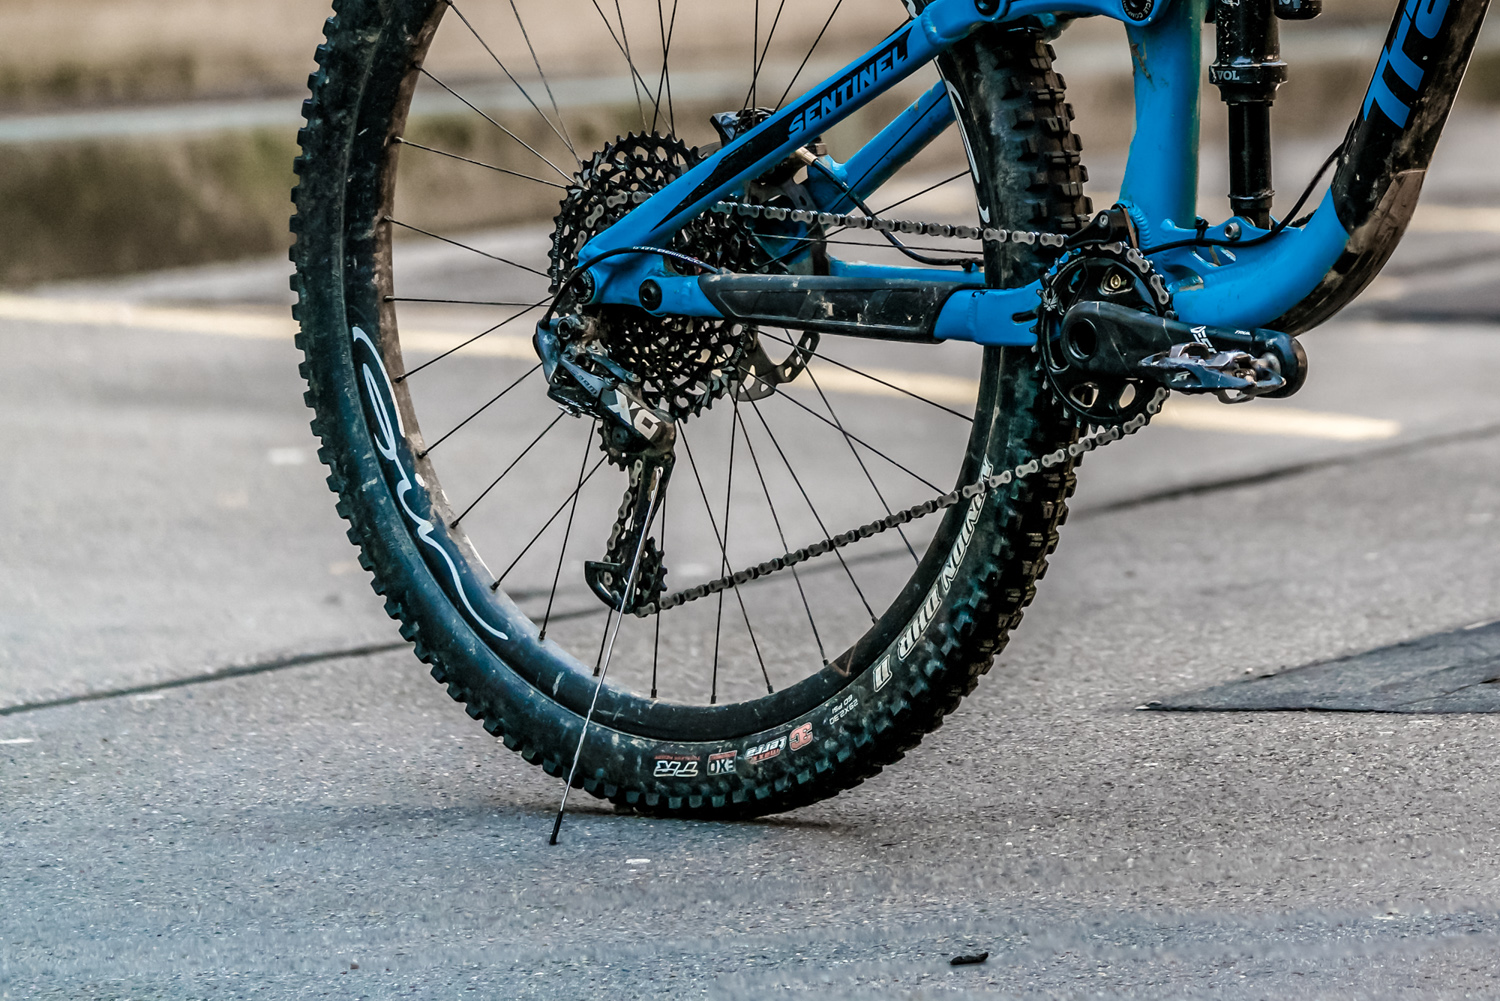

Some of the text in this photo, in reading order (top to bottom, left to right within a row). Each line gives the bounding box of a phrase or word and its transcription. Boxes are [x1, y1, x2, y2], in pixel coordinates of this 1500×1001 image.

[788, 46, 907, 136] SENTINEL
[897, 583, 942, 661] DHR
[653, 760, 699, 778] TR
